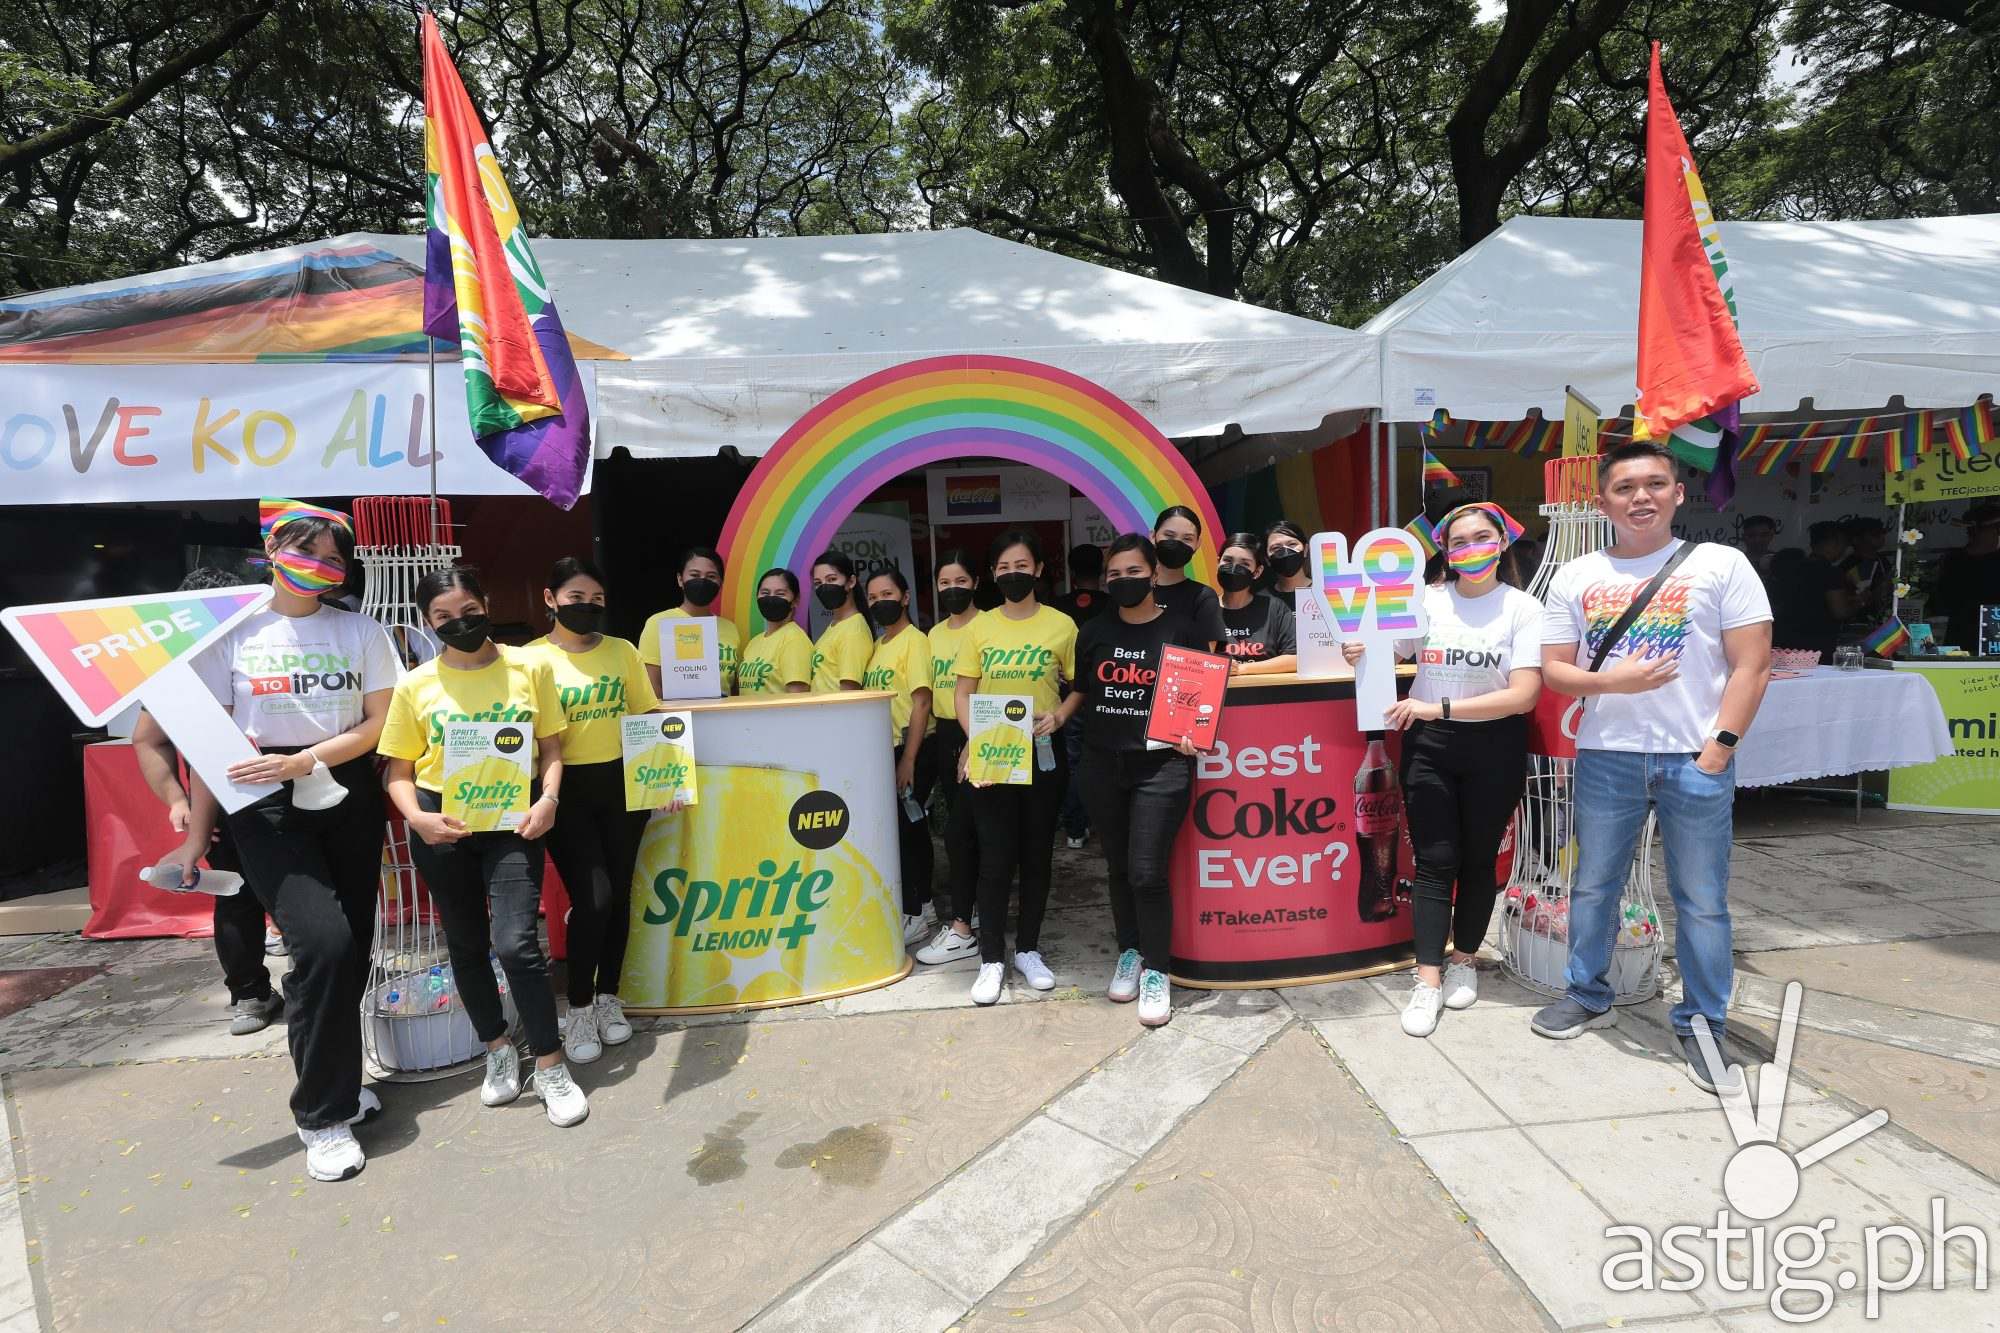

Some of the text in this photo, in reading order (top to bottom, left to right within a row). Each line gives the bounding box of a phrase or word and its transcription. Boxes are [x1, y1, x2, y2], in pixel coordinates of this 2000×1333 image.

[192, 397, 296, 474] KO
[321, 389, 444, 468] ALL
[1936, 447, 2000, 481] tte
[71, 608, 202, 668] PRIDE
[1225, 641, 1265, 656] oke
[1113, 648, 1146, 659] Best
[1166, 653, 1185, 663] Best
[1203, 661, 1225, 670] Ever?
[673, 664, 708, 672] COOLING
[738, 656, 773, 678] prite
[1097, 661, 1156, 685] Coke
[260, 680, 282, 691] TO
[555, 675, 625, 715] prit
[1104, 686, 1145, 700] Ever?
[1006, 706, 1025, 714] NEW
[1095, 705, 1150, 716] #TakeATast
[431, 702, 533, 746] Sit
[663, 723, 683, 732] NEW
[496, 736, 521, 745] NEW
[978, 743, 1026, 761] Sprite
[1197, 735, 1322, 780] Best
[634, 762, 688, 785] Sprite
[454, 780, 522, 804] Sprite
[797, 809, 843, 831] NEW
[1198, 842, 1349, 888] Ever?
[643, 859, 834, 937] Sprite
[1199, 906, 1328, 925] #TakeATaste
